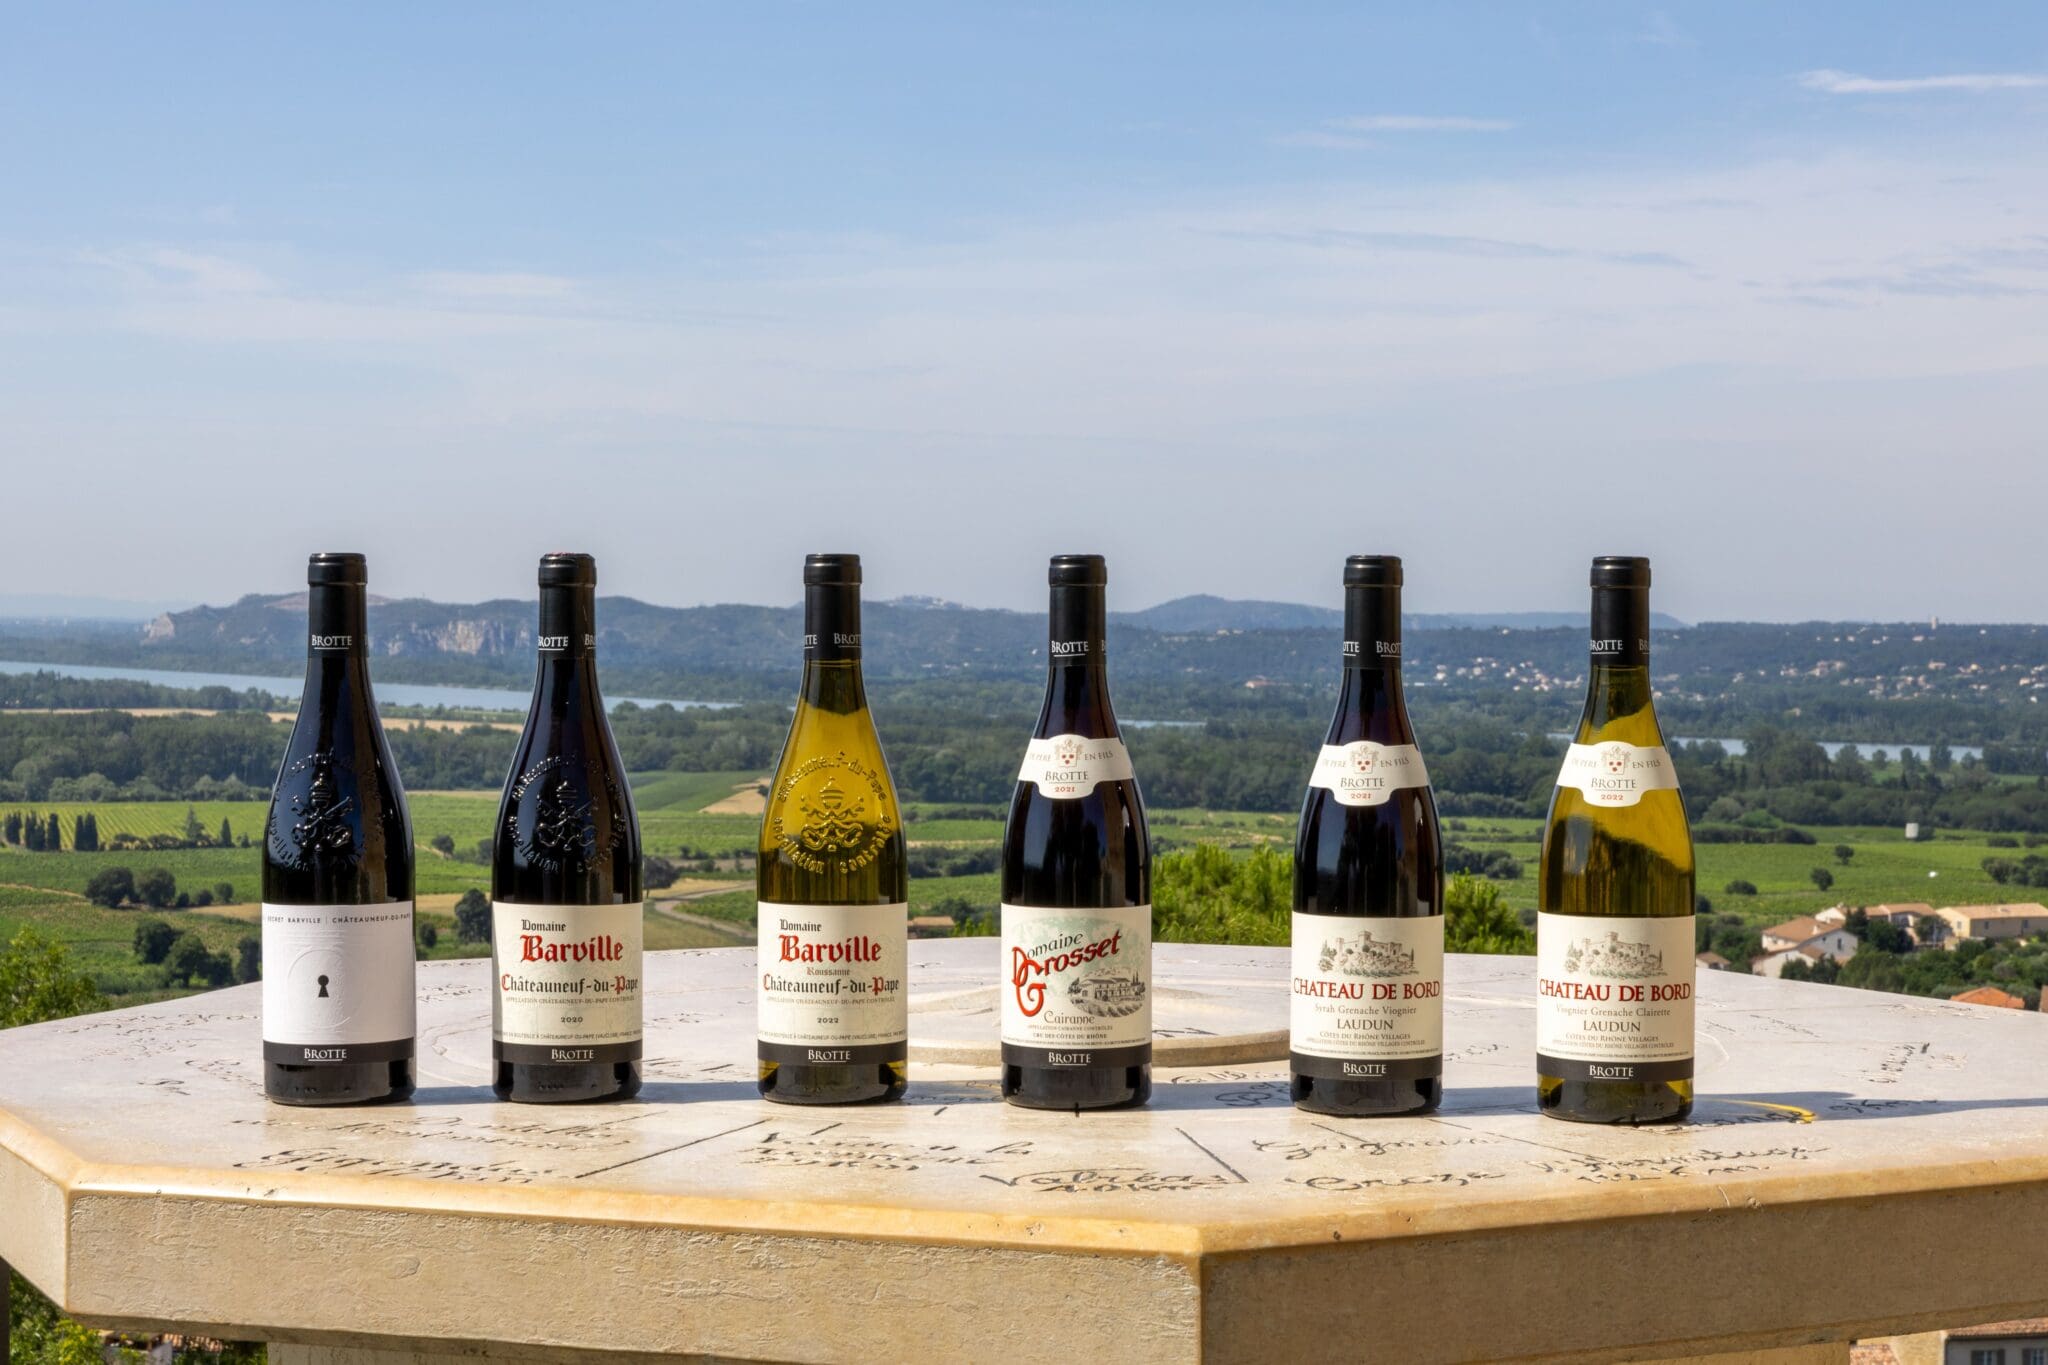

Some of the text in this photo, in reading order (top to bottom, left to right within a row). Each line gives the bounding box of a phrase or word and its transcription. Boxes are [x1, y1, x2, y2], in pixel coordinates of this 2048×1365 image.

[312, 634, 352, 647] BROTTE
[538, 635, 569, 647] ROTTE
[834, 632, 863, 645] BROT
[1051, 640, 1089, 653] BROTTE
[1376, 641, 1402, 653] BROT
[1590, 639, 1623, 651] ROTTE
[1045, 770, 1089, 781] BROTTE
[1340, 777, 1385, 788] BROTTE
[1591, 777, 1638, 789] BROTTE
[1350, 792, 1372, 800] 2021
[521, 919, 566, 932] Domaine
[779, 919, 822, 932] Domaine
[520, 934, 623, 963] Barville
[779, 934, 882, 963] Barville
[1294, 978, 1440, 1000] CHATEAU DE BORD
[1539, 979, 1691, 1002] CHATEAU DE BORD
[1314, 1003, 1417, 1017] Syrah Grenache Viognier
[1591, 1006, 1633, 1017] Grenache
[1636, 1007, 1671, 1017] Clairette
[1044, 1011, 1095, 1025] Cairanne
[1337, 1019, 1393, 1031] LAUDUN
[1583, 1020, 1641, 1033] LAUDUN
[304, 1048, 347, 1059] BROTTE
[551, 1049, 594, 1060] BROTTE
[808, 1050, 851, 1061] BROTTE
[1048, 1052, 1091, 1064] BROTTE
[1343, 1062, 1386, 1074] BROTTE
[1589, 1065, 1634, 1077] BROTTE
